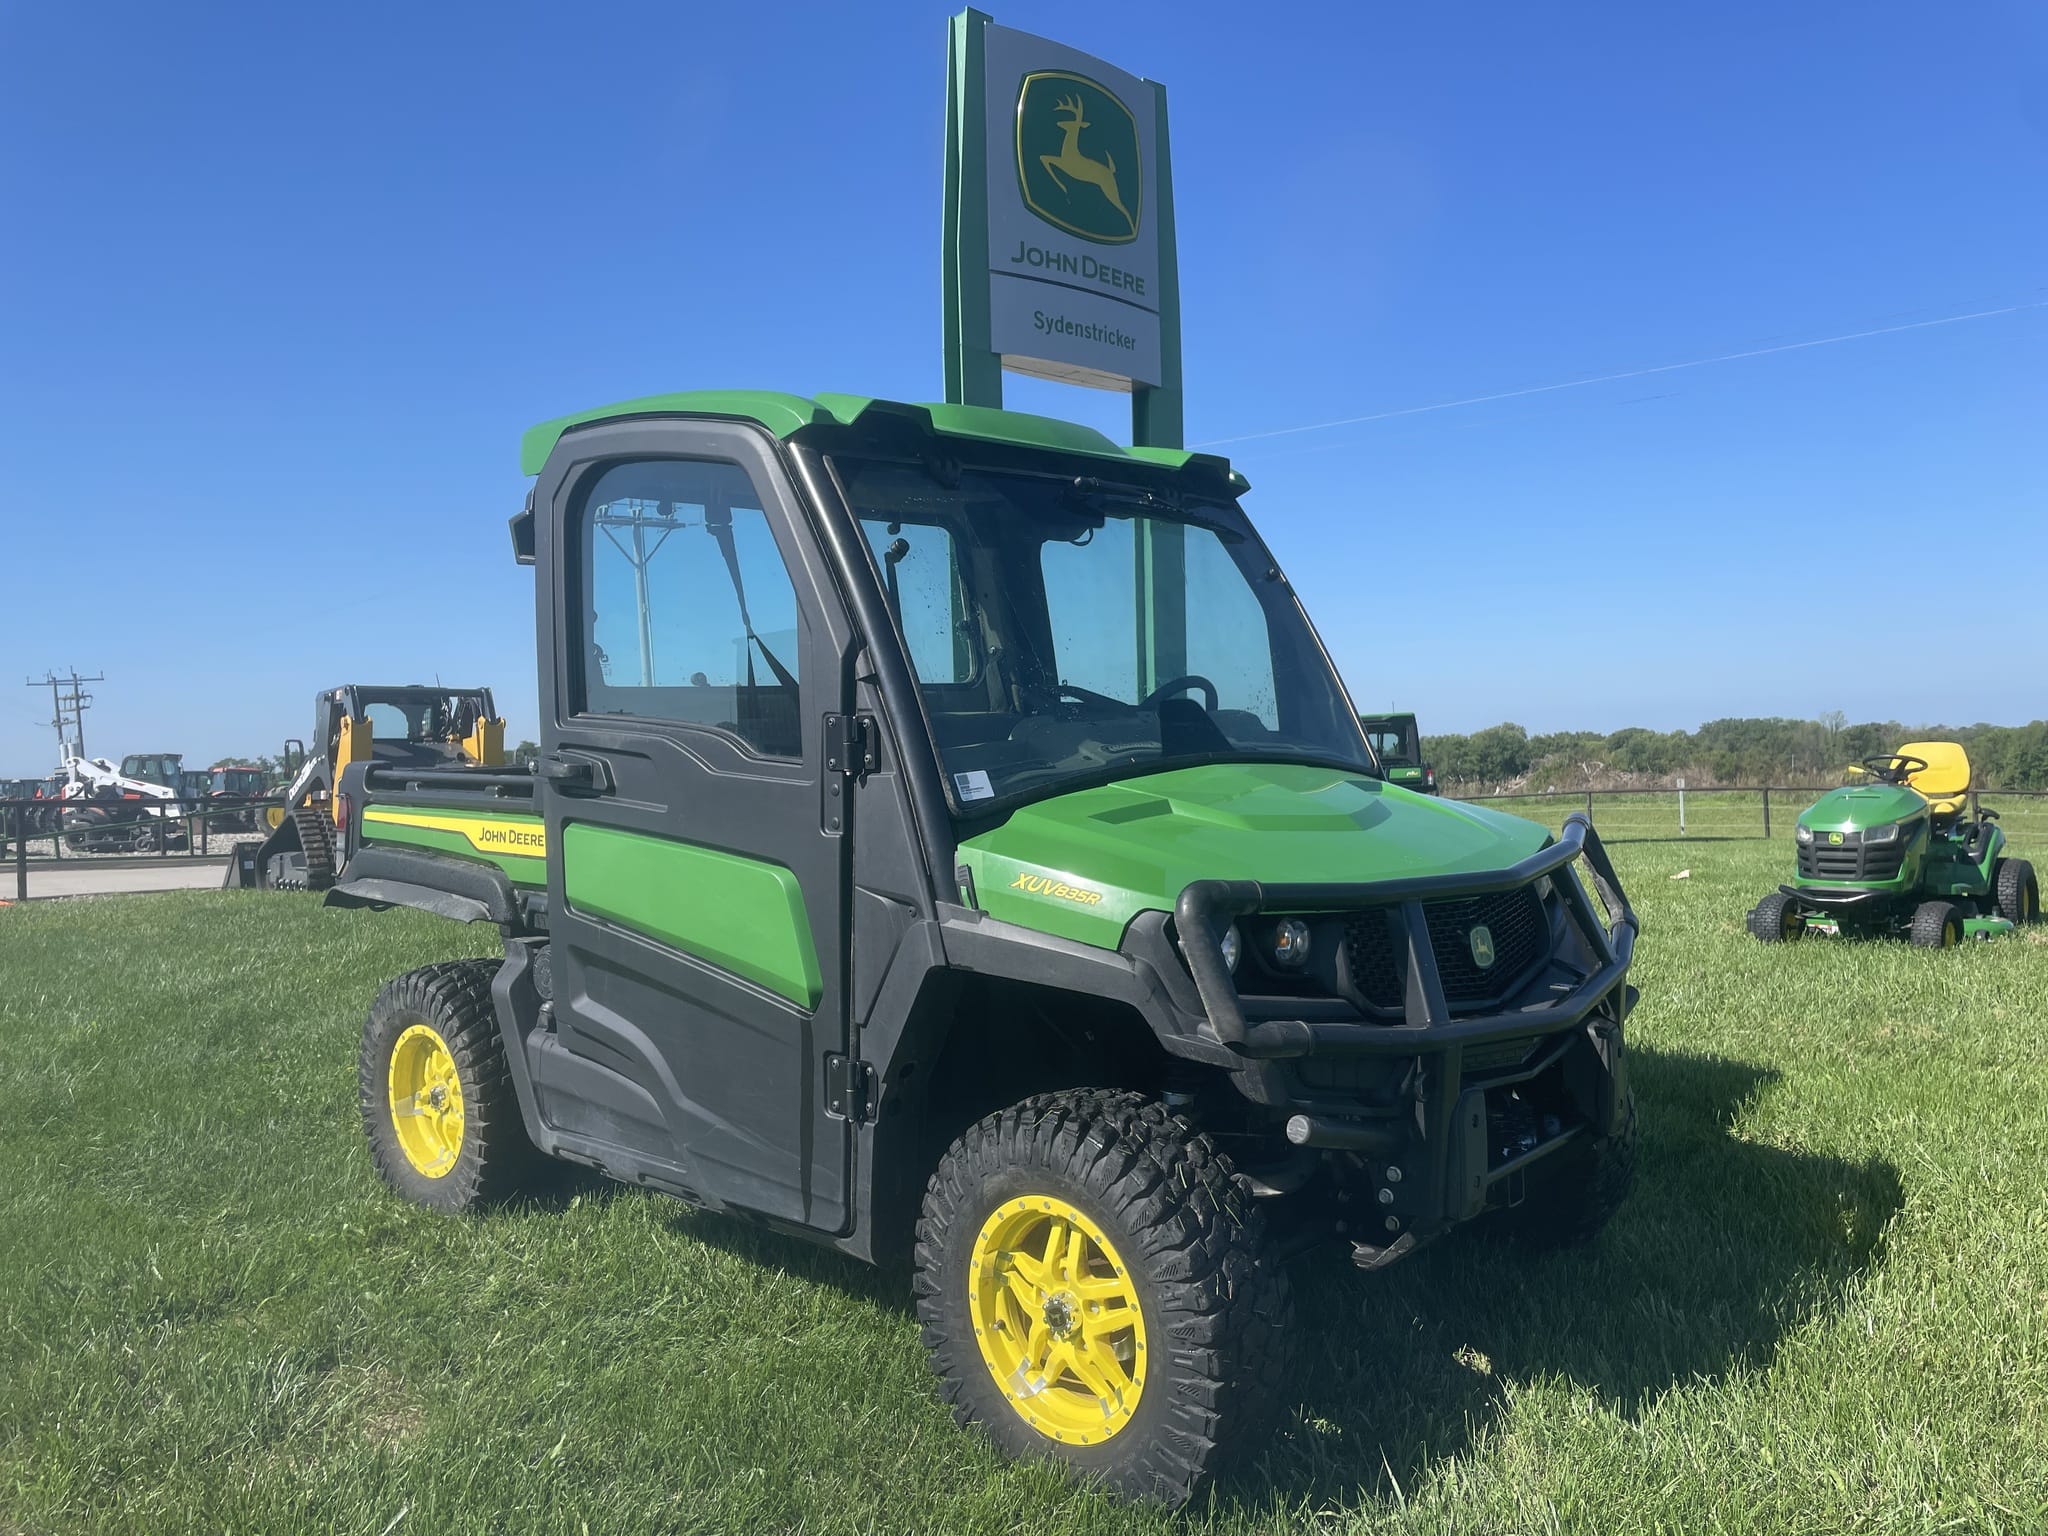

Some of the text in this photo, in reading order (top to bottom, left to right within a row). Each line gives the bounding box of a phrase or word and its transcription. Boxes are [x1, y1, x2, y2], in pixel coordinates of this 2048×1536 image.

[1011, 241, 1146, 297] JOHN DEERE
[1033, 310, 1137, 351] Sydenstricker
[479, 826, 545, 847] JOHN DEERE
[1009, 871, 1102, 906] XUV835R
